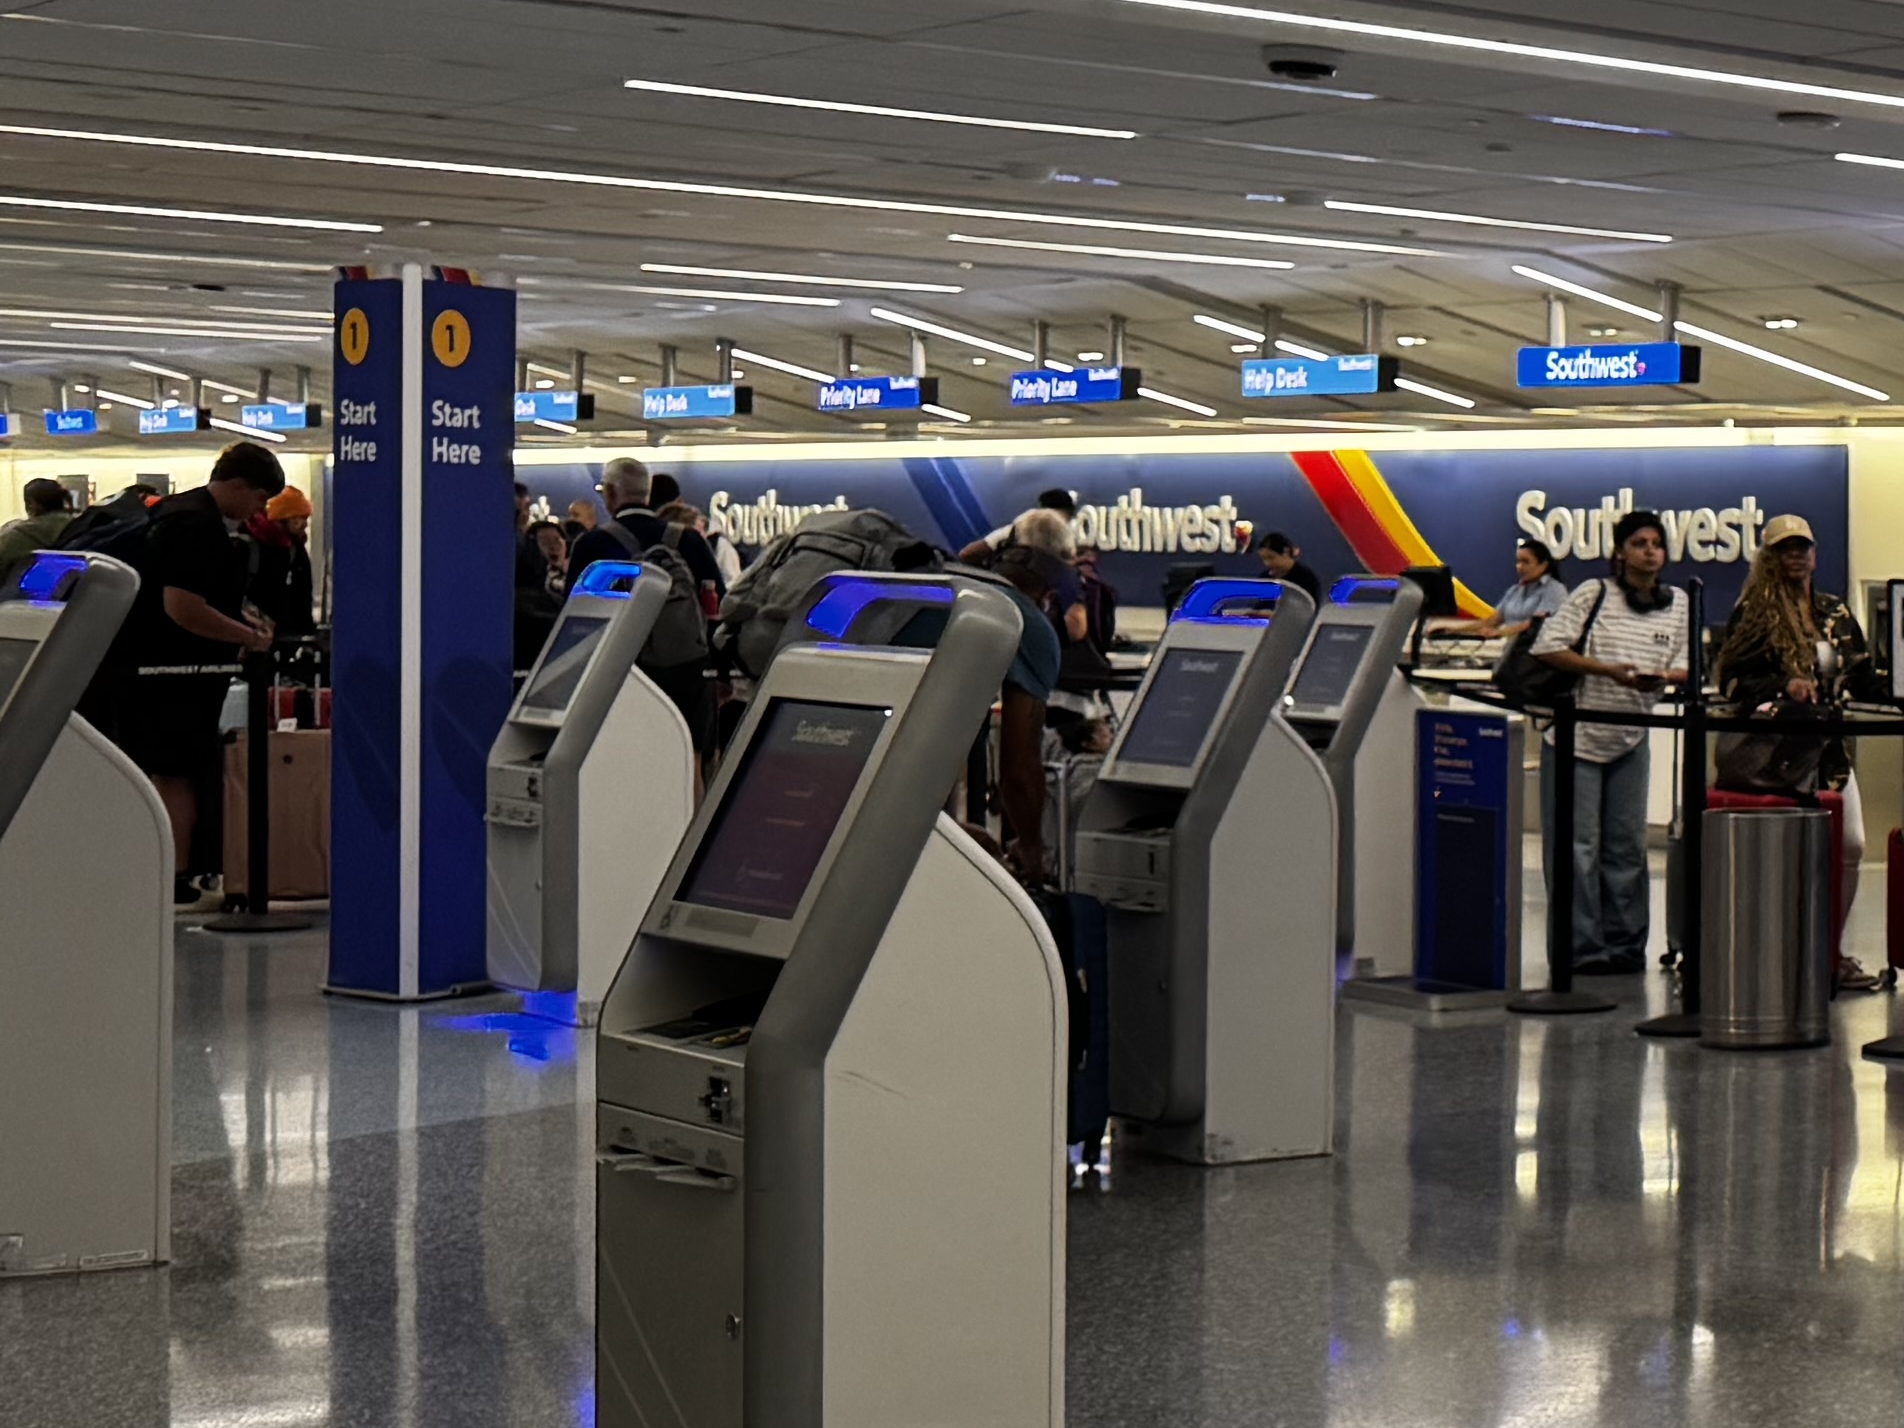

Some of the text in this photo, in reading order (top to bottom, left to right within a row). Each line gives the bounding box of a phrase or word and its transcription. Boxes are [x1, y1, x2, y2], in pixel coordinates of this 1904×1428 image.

[350, 322, 357, 350] 1
[446, 324, 455, 352] 1
[1244, 369, 1273, 391] Help
[1275, 367, 1307, 388] Desk
[1546, 349, 1638, 381] Southwest
[340, 399, 377, 425] Start
[432, 400, 481, 429] Start
[340, 435, 377, 462] Here
[432, 436, 481, 465] Here
[1065, 488, 1238, 553] outhwest
